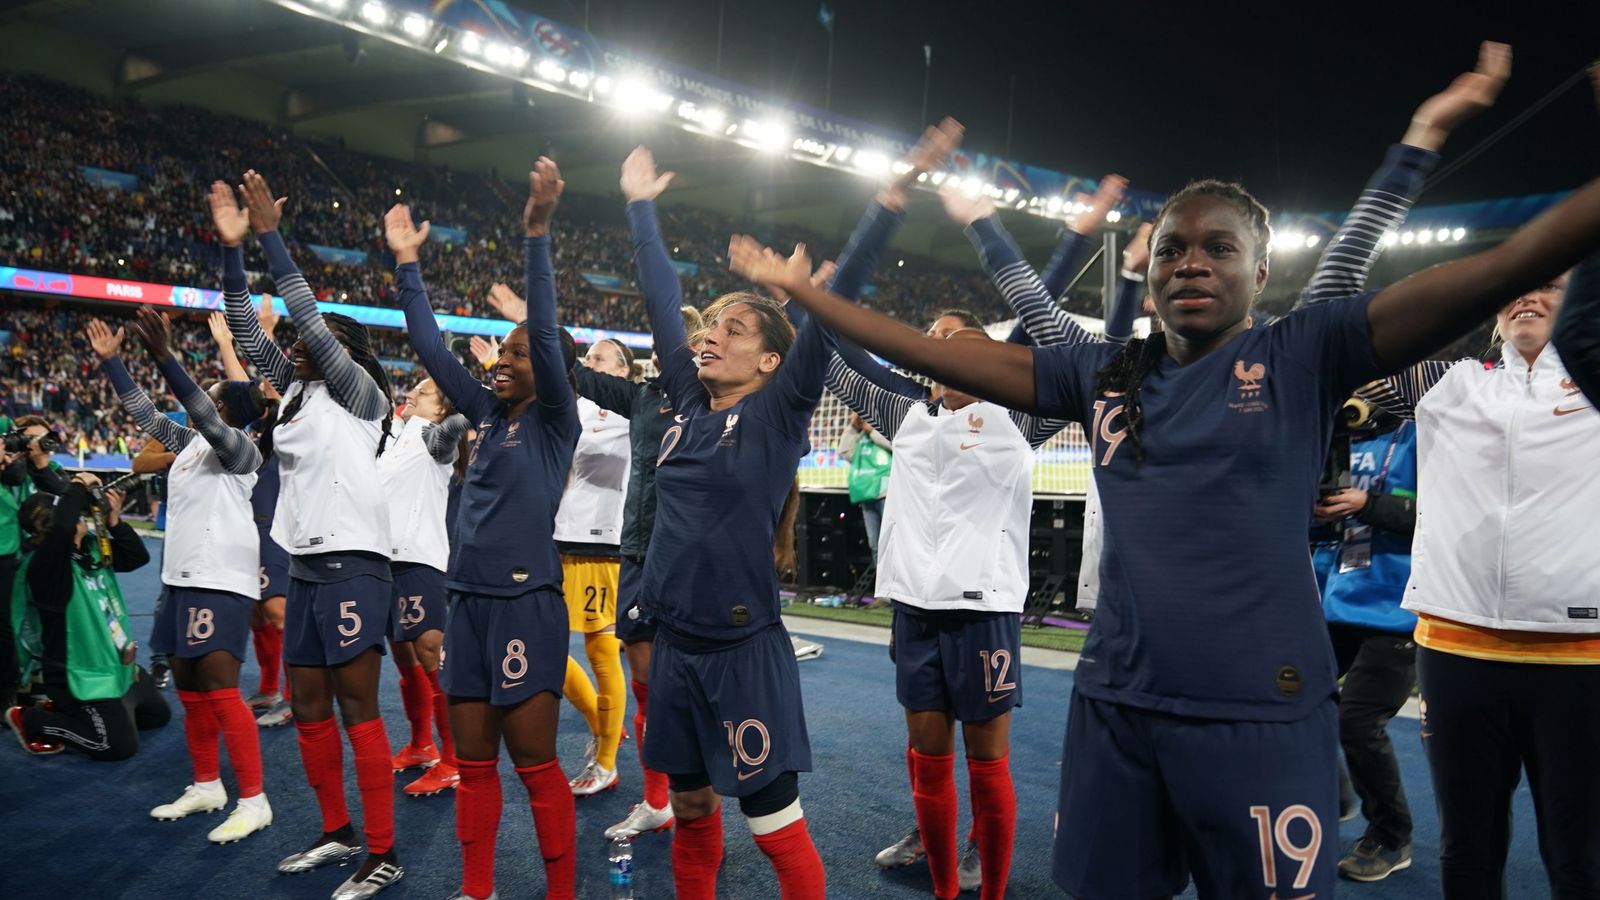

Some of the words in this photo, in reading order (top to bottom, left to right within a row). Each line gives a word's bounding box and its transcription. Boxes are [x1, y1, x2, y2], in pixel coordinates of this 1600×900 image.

[106, 283, 143, 298] PARIS
[1350, 451, 1376, 471] FA
[399, 595, 425, 624] 23
[584, 585, 607, 613] 21
[186, 607, 215, 639] 18
[337, 601, 362, 637] 5
[502, 639, 528, 679] 8
[979, 649, 1016, 692] 12
[723, 718, 771, 768] 10
[1249, 804, 1322, 889] 19
